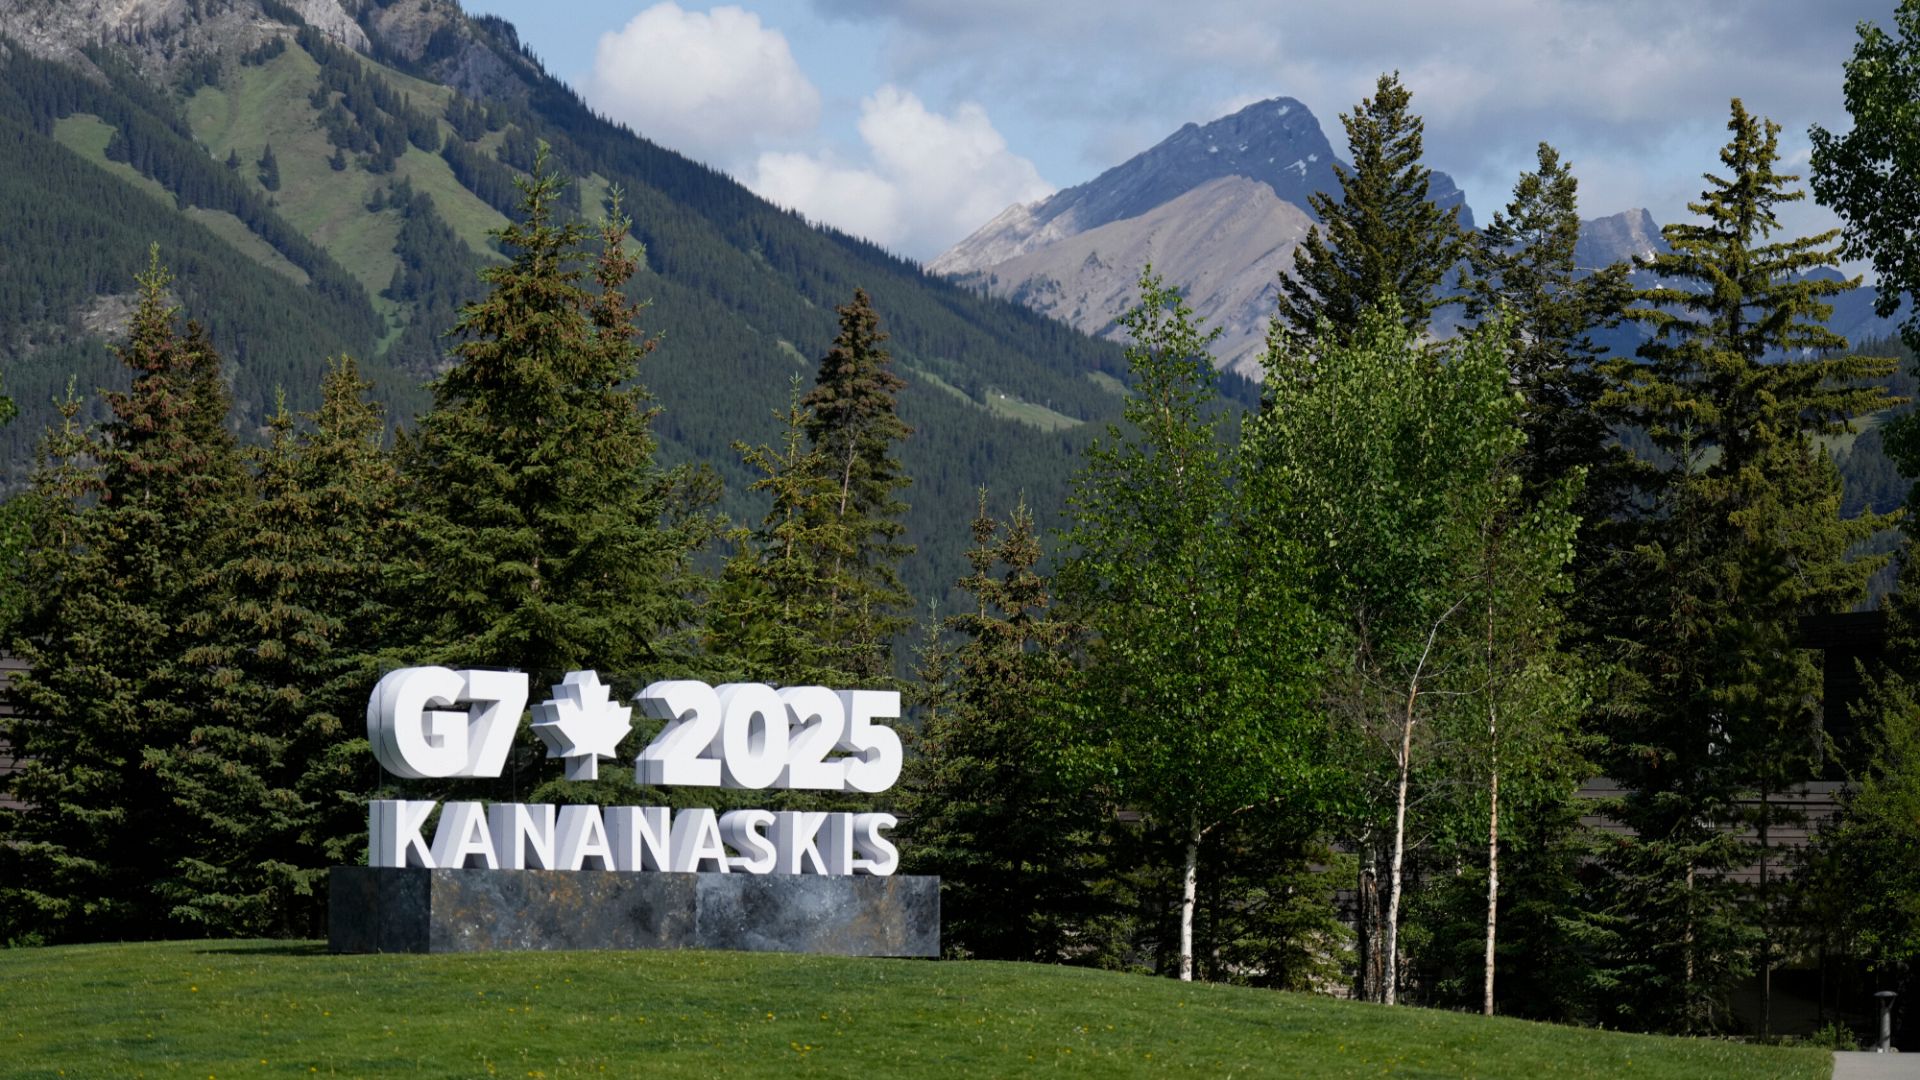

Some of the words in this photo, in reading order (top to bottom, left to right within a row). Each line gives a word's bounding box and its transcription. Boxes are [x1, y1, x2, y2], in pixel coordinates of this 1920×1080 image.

[367, 666, 528, 778] G7
[636, 680, 903, 793] 2025
[369, 800, 899, 876] KANANASKIS
